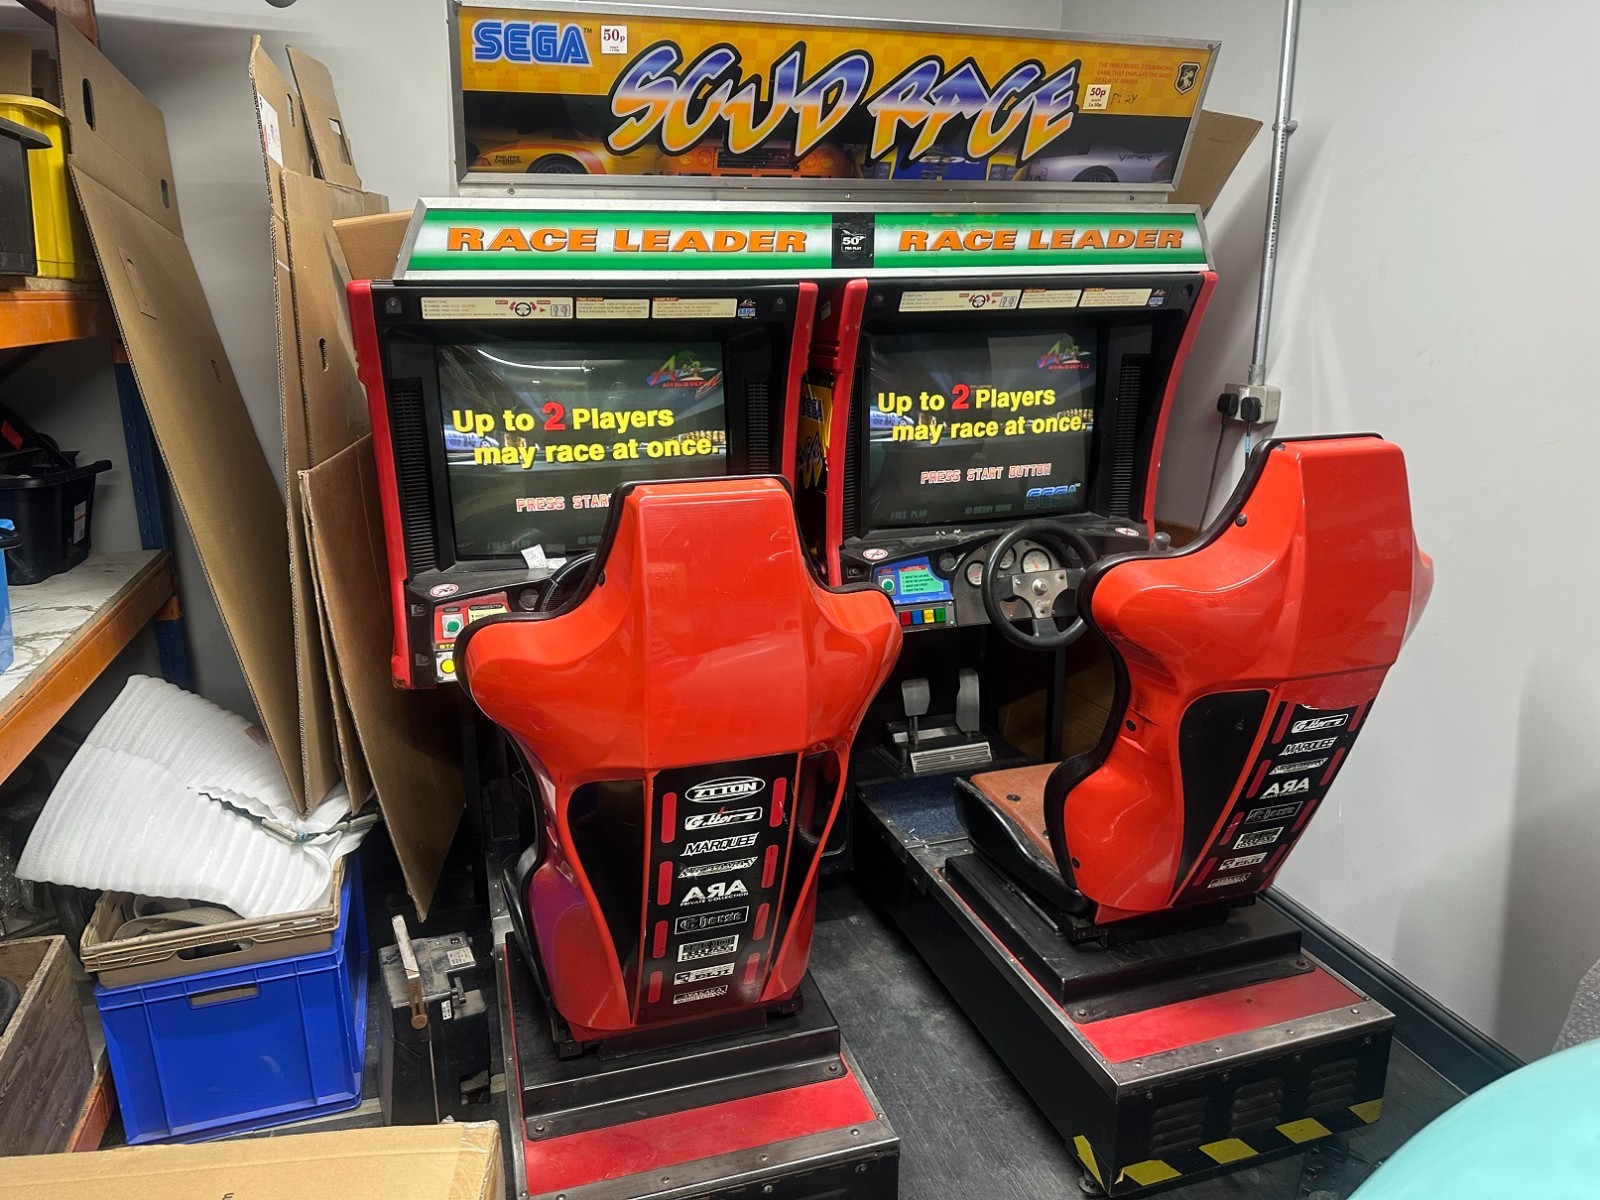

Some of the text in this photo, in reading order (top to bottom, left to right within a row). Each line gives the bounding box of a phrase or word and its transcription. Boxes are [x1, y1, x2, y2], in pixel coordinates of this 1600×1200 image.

[472, 20, 592, 66] SEGA
[603, 29, 625, 43] 50p
[1090, 87, 1106, 98] 50p
[446, 226, 808, 253] RACE LEADER
[899, 228, 1184, 252] RACE LEADER
[878, 384, 1056, 416] Up to 2 Players
[452, 402, 674, 437] Up to 2 Players
[892, 416, 1087, 445] may race at once.
[474, 438, 720, 470] may race at once.
[920, 462, 1052, 484] PRESS START BUTTON
[516, 493, 612, 512] PRESS STAR
[683, 833, 758, 856] MARQUEE
[707, 892, 749, 902] COLLECTION
